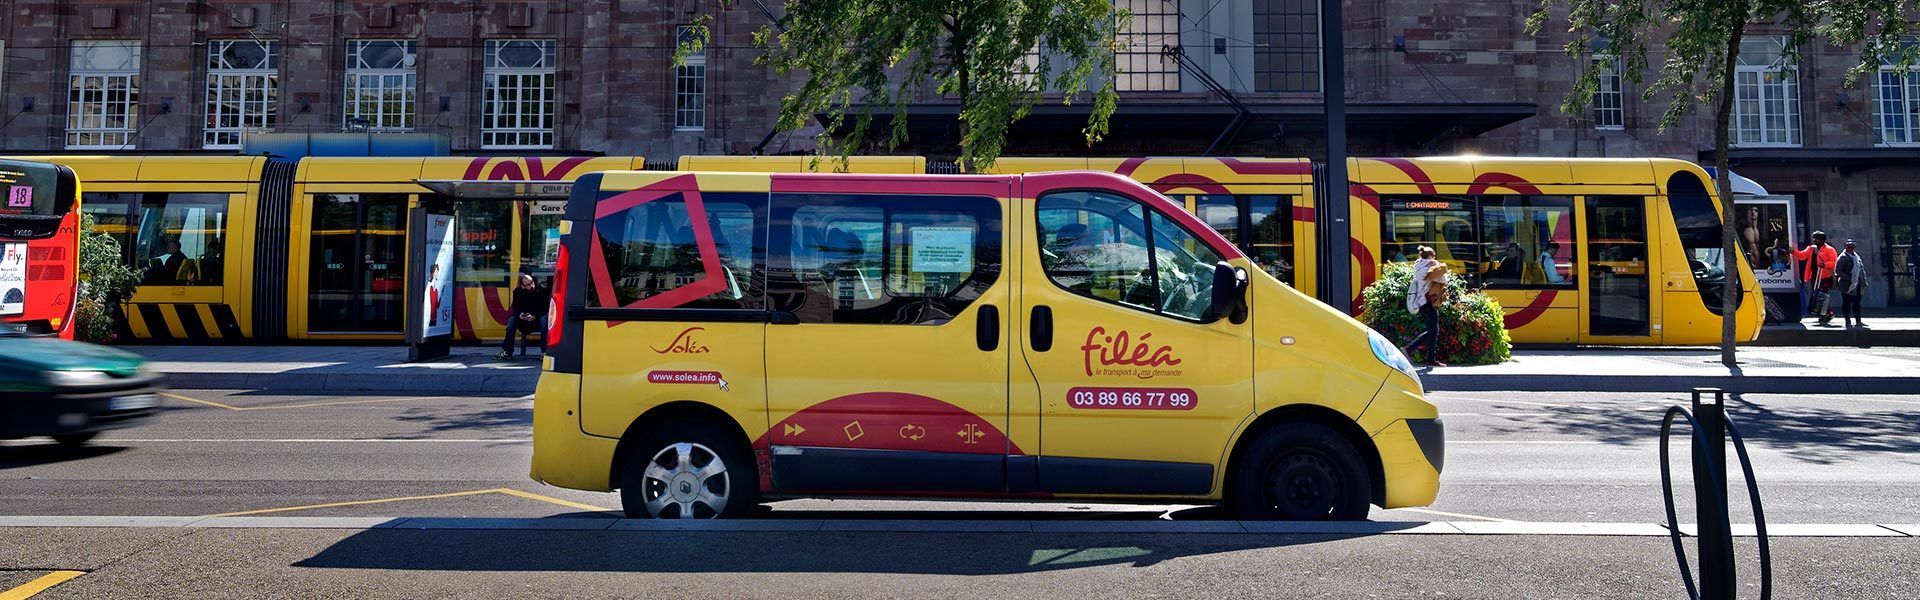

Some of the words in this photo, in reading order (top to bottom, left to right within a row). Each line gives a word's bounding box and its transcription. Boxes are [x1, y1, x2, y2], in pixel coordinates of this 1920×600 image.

[15, 188, 27, 204] 18
[649, 327, 710, 354] Soléa
[1081, 326, 1182, 377] filéa
[652, 372, 716, 382] www.solea.info
[1103, 369, 1131, 378] transport
[1153, 369, 1182, 377] demande
[1074, 391, 1094, 406] 03
[1098, 391, 1118, 406] 89
[1122, 392, 1142, 407] 66
[1146, 392, 1164, 407] 77
[1169, 392, 1190, 407] 99
